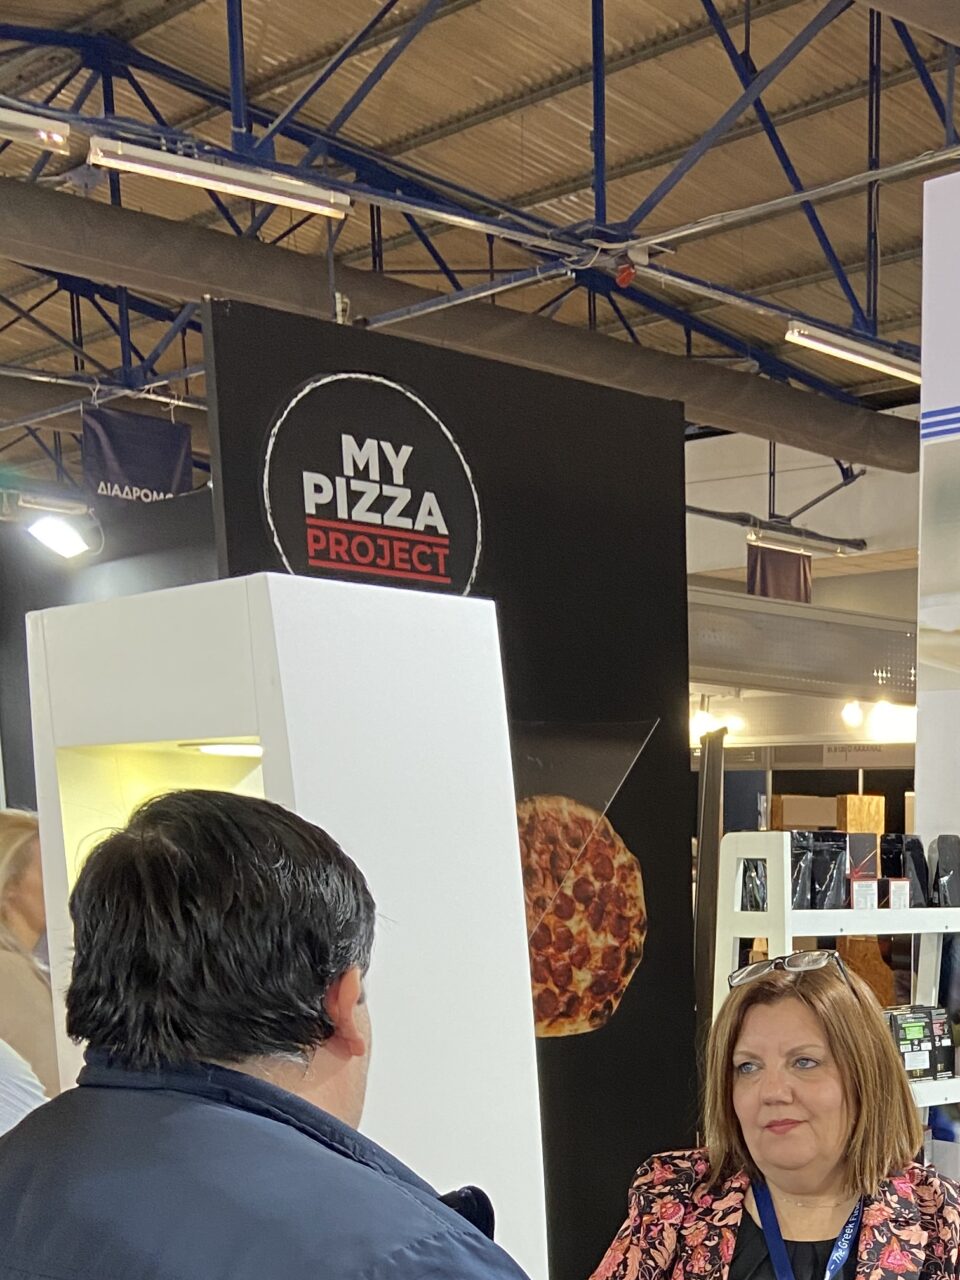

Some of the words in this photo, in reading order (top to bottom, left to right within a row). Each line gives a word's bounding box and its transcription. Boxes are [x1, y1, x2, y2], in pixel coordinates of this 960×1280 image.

[341, 433, 414, 486] MY
[302, 471, 450, 536] PIZZA
[307, 528, 450, 575] PROJECT
[838, 1223, 855, 1249] Greek
